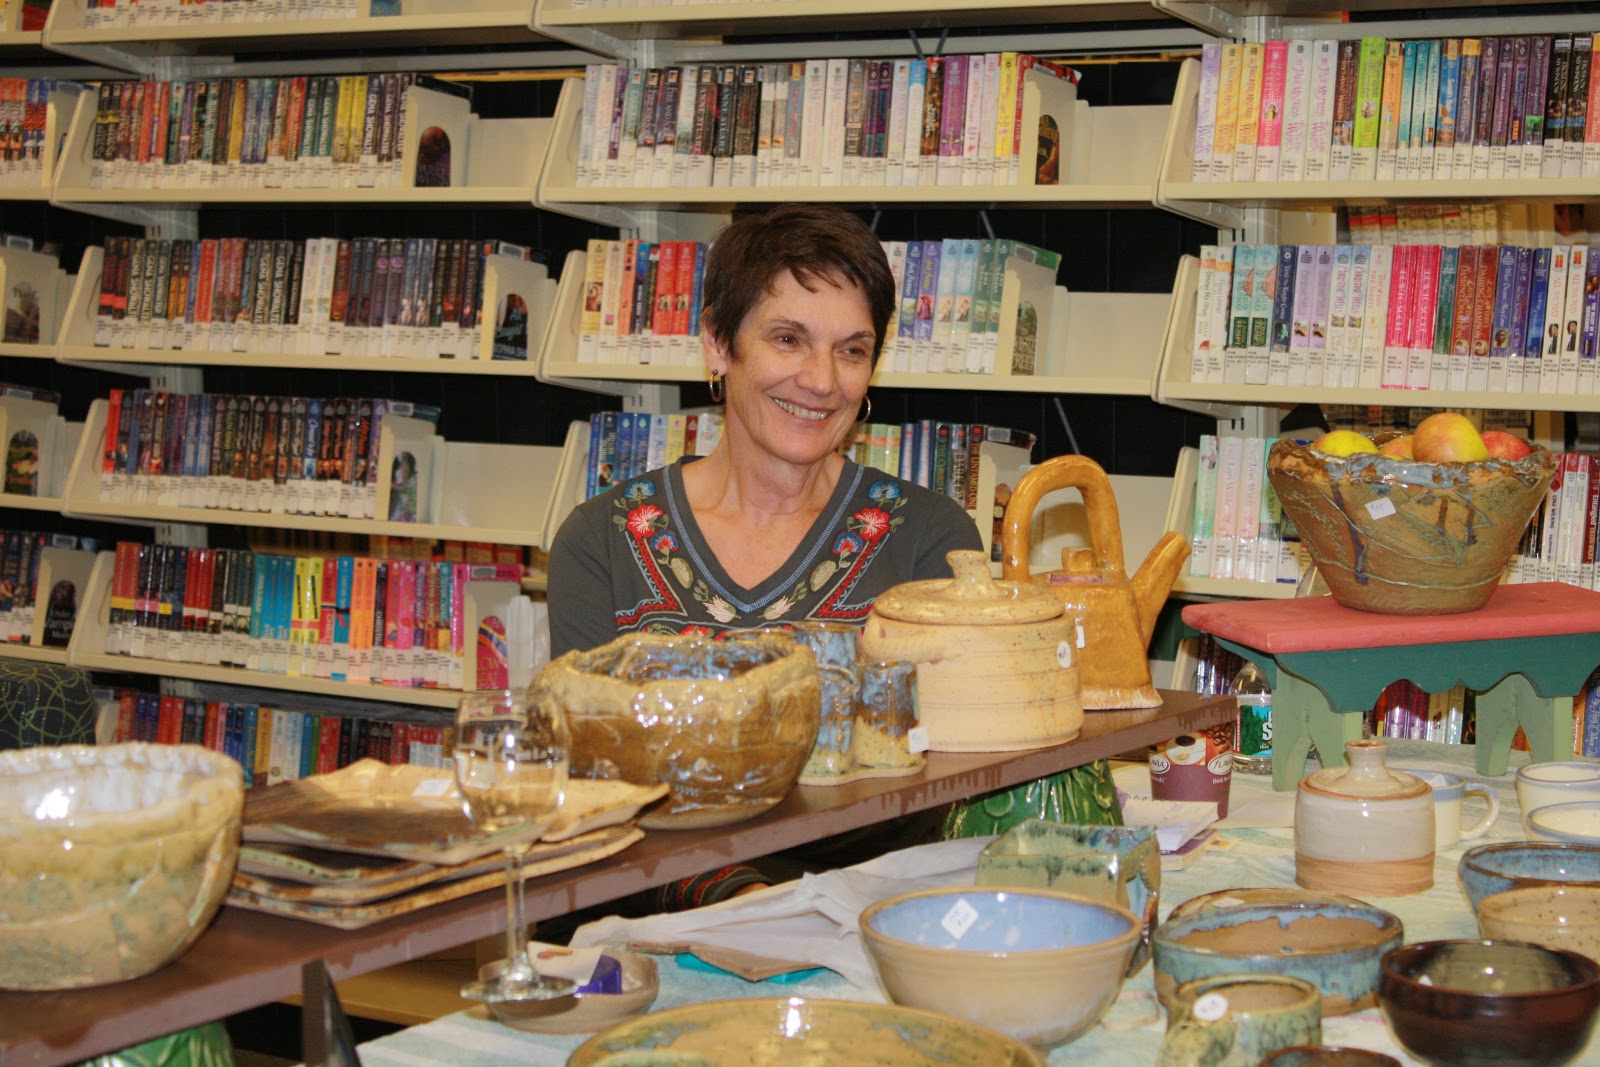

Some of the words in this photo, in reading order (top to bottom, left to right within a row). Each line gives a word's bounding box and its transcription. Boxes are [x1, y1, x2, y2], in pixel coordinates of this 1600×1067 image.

[367, 94, 377, 114] GENA
[303, 119, 312, 156] SHOWALTE
[319, 117, 330, 155] SHOWALTE
[363, 116, 374, 155] SHOWALTE
[127, 278, 139, 318] SHOWALTE
[141, 279, 152, 320] SHOWALTE
[1281, 286, 1289, 303] Knight
[1458, 265, 1467, 298] DASHING
[1477, 265, 1487, 298] DASHING
[254, 282, 266, 324] SHOWALTE
[270, 281, 282, 324] SHOWALTE
[1455, 299, 1465, 339] CHAMPION
[1474, 299, 1482, 339] CHAMPION
[1589, 495, 1598, 525] Entangled
